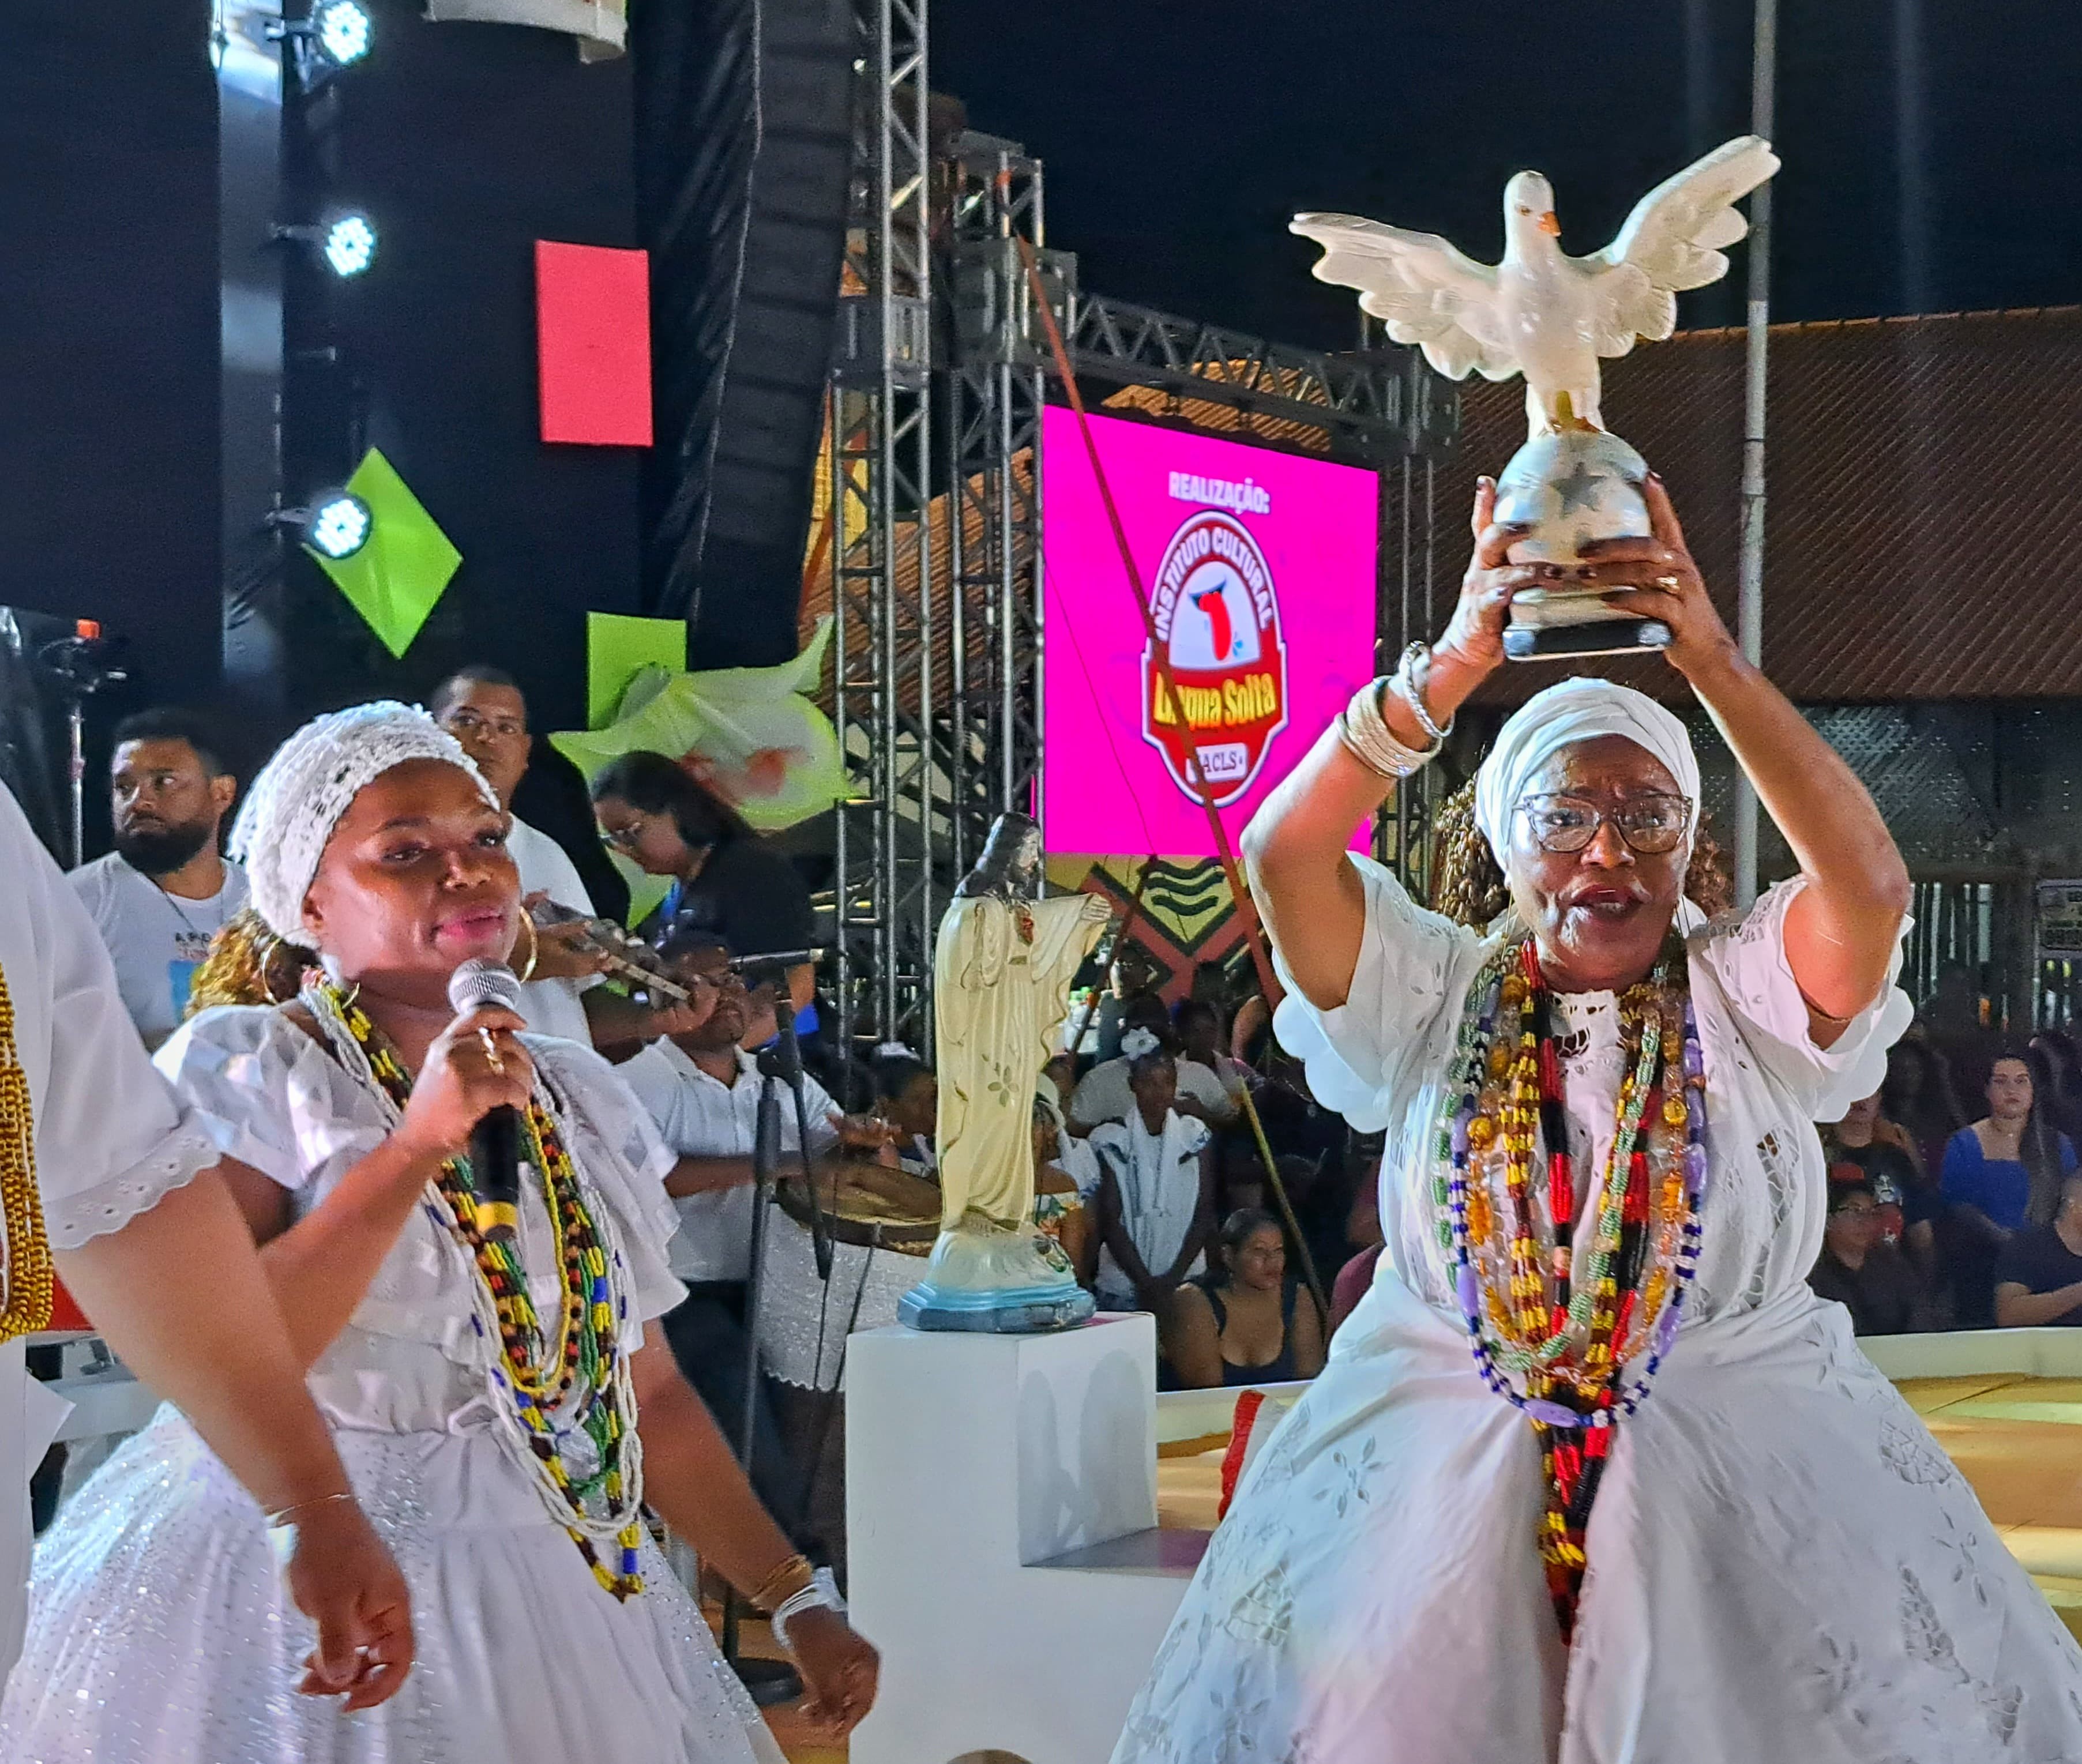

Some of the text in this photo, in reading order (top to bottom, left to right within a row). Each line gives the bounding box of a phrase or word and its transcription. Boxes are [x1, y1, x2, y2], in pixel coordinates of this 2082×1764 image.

[1155, 526, 1272, 642] INSTITUTO CULTURAL
[1223, 673, 1276, 727] Solta
